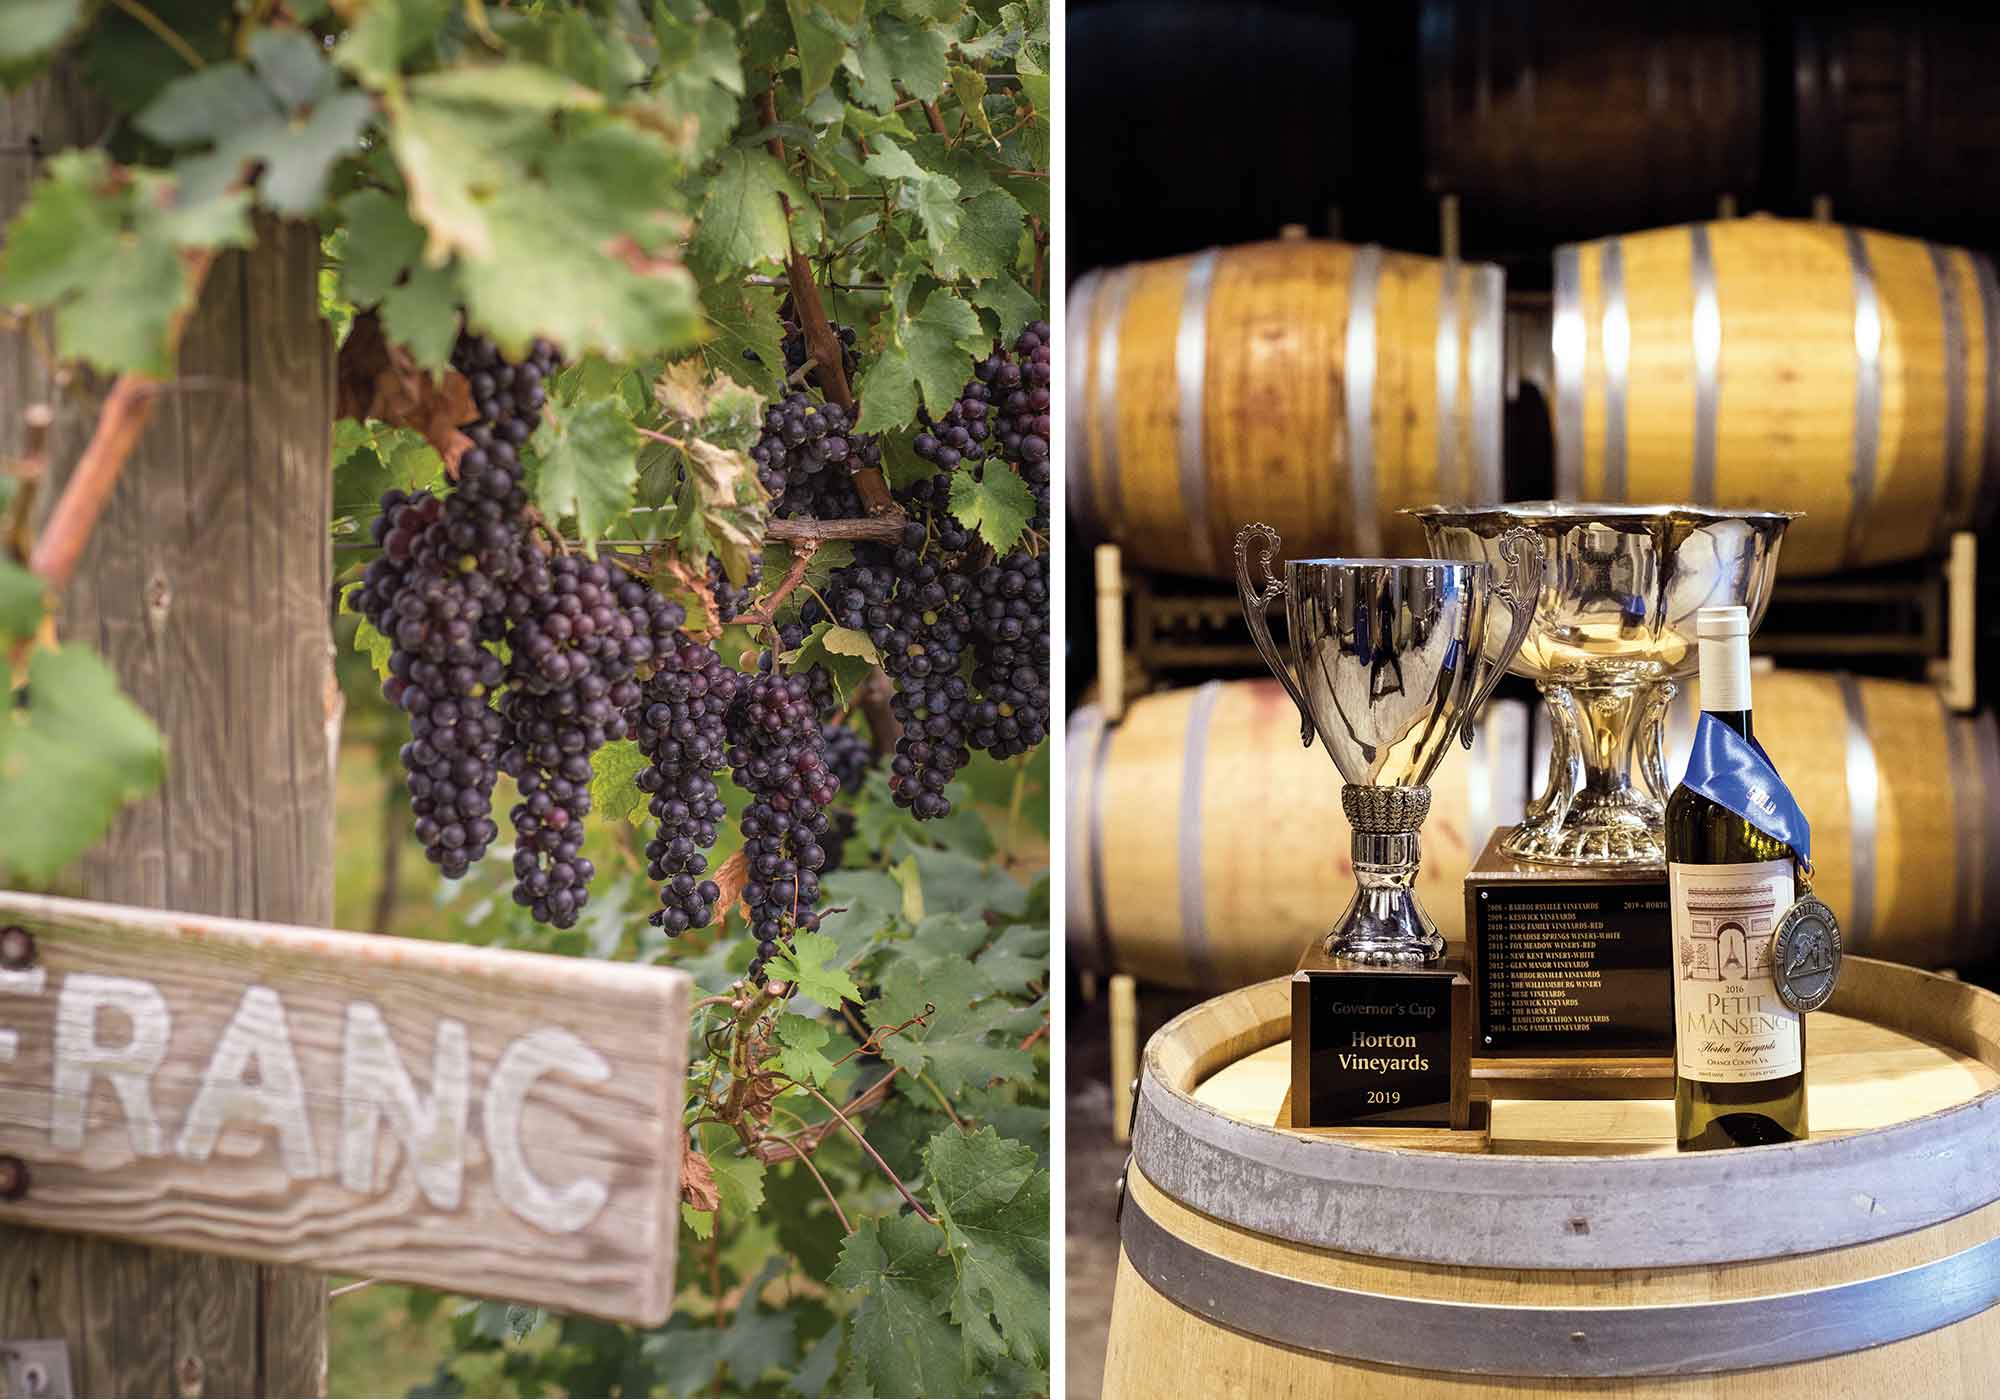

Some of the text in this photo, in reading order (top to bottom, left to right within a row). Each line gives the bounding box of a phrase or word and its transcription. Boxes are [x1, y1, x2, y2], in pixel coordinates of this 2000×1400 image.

[1511, 971, 1563, 979] BARBOURSVILLE
[1511, 981, 1524, 989] THE
[1725, 985, 1744, 994] 2016
[1530, 990, 1566, 998] VINEYARDS
[1707, 993, 1768, 1015] PETIT
[1332, 1002, 1436, 1019] Governor's Cup
[1548, 1007, 1557, 1015] AT
[1573, 1015, 1610, 1023] VINEYARDS
[1687, 1013, 1788, 1035] MANSENG
[1511, 1024, 1529, 1032] KING
[1530, 1024, 1552, 1032] FAMILY
[1352, 1031, 1416, 1048] Horton
[1698, 1040, 1776, 1056] Horton Vineyards
[1338, 1054, 1429, 1074] Vineyards
[1367, 1091, 1401, 1104] 2019
